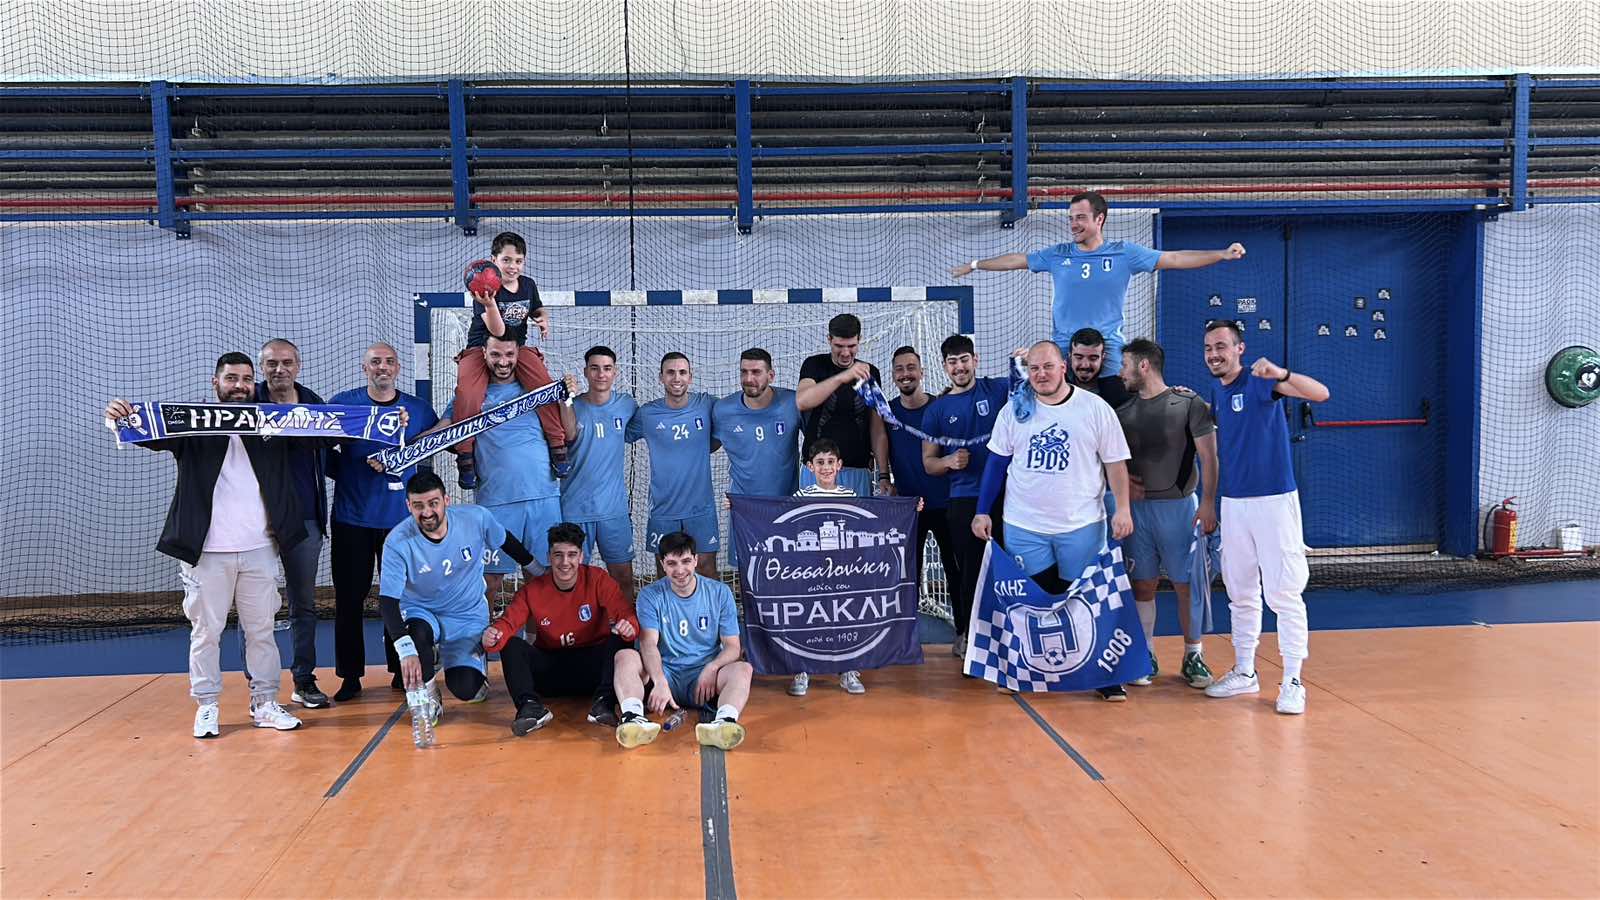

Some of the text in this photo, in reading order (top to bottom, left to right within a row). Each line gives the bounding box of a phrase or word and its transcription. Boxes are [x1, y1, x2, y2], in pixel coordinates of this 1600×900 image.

[1081, 263, 1091, 279] 3
[190, 408, 346, 430] ΗΡΑΚΛΗΣ
[594, 422, 605, 439] 11
[671, 424, 690, 441] 24
[755, 426, 765, 442] 9
[1026, 449, 1070, 471] 1908
[481, 548, 500, 566] 94
[442, 558, 453, 577] 2
[765, 557, 892, 581] Θεσσαλονίκη
[757, 591, 902, 626] ΗΡΑΚΛΗ
[679, 619, 688, 637] 8
[838, 631, 858, 642] 1908
[560, 633, 575, 648] 16
[1097, 628, 1133, 673] 1908
